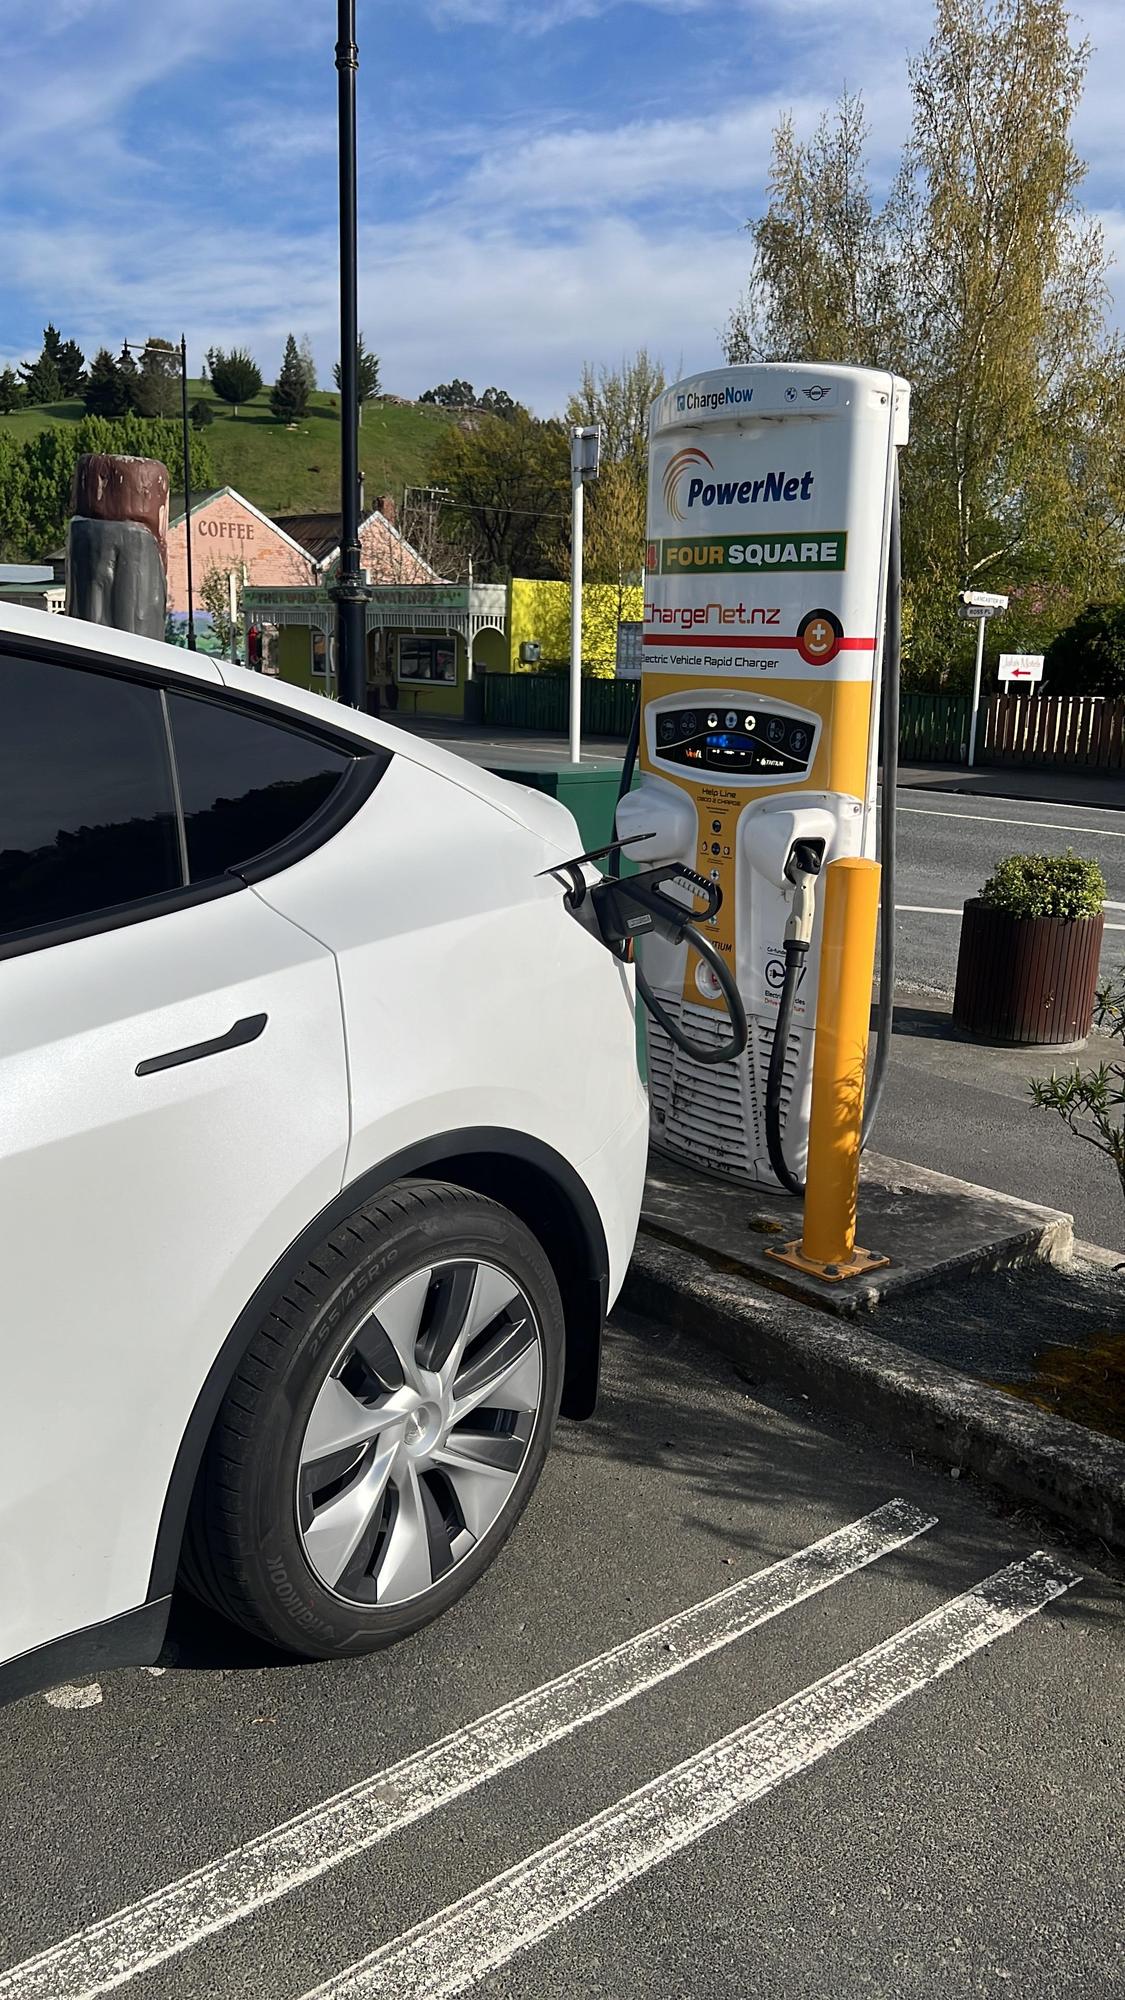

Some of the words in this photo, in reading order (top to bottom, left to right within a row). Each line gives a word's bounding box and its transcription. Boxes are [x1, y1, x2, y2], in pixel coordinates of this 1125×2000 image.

[687, 387, 753, 410] ChargeNow
[688, 471, 814, 507] PowerNet
[198, 520, 254, 540] COFFEE
[666, 546, 724, 566] FOUR
[728, 542, 838, 566] SQUARE
[670, 655, 702, 665] Vehicle
[704, 656, 733, 668] Rapid
[735, 657, 779, 670] Charger
[702, 788, 718, 797] Help
[720, 789, 736, 799] Line
[711, 940, 732, 952] TIUM
